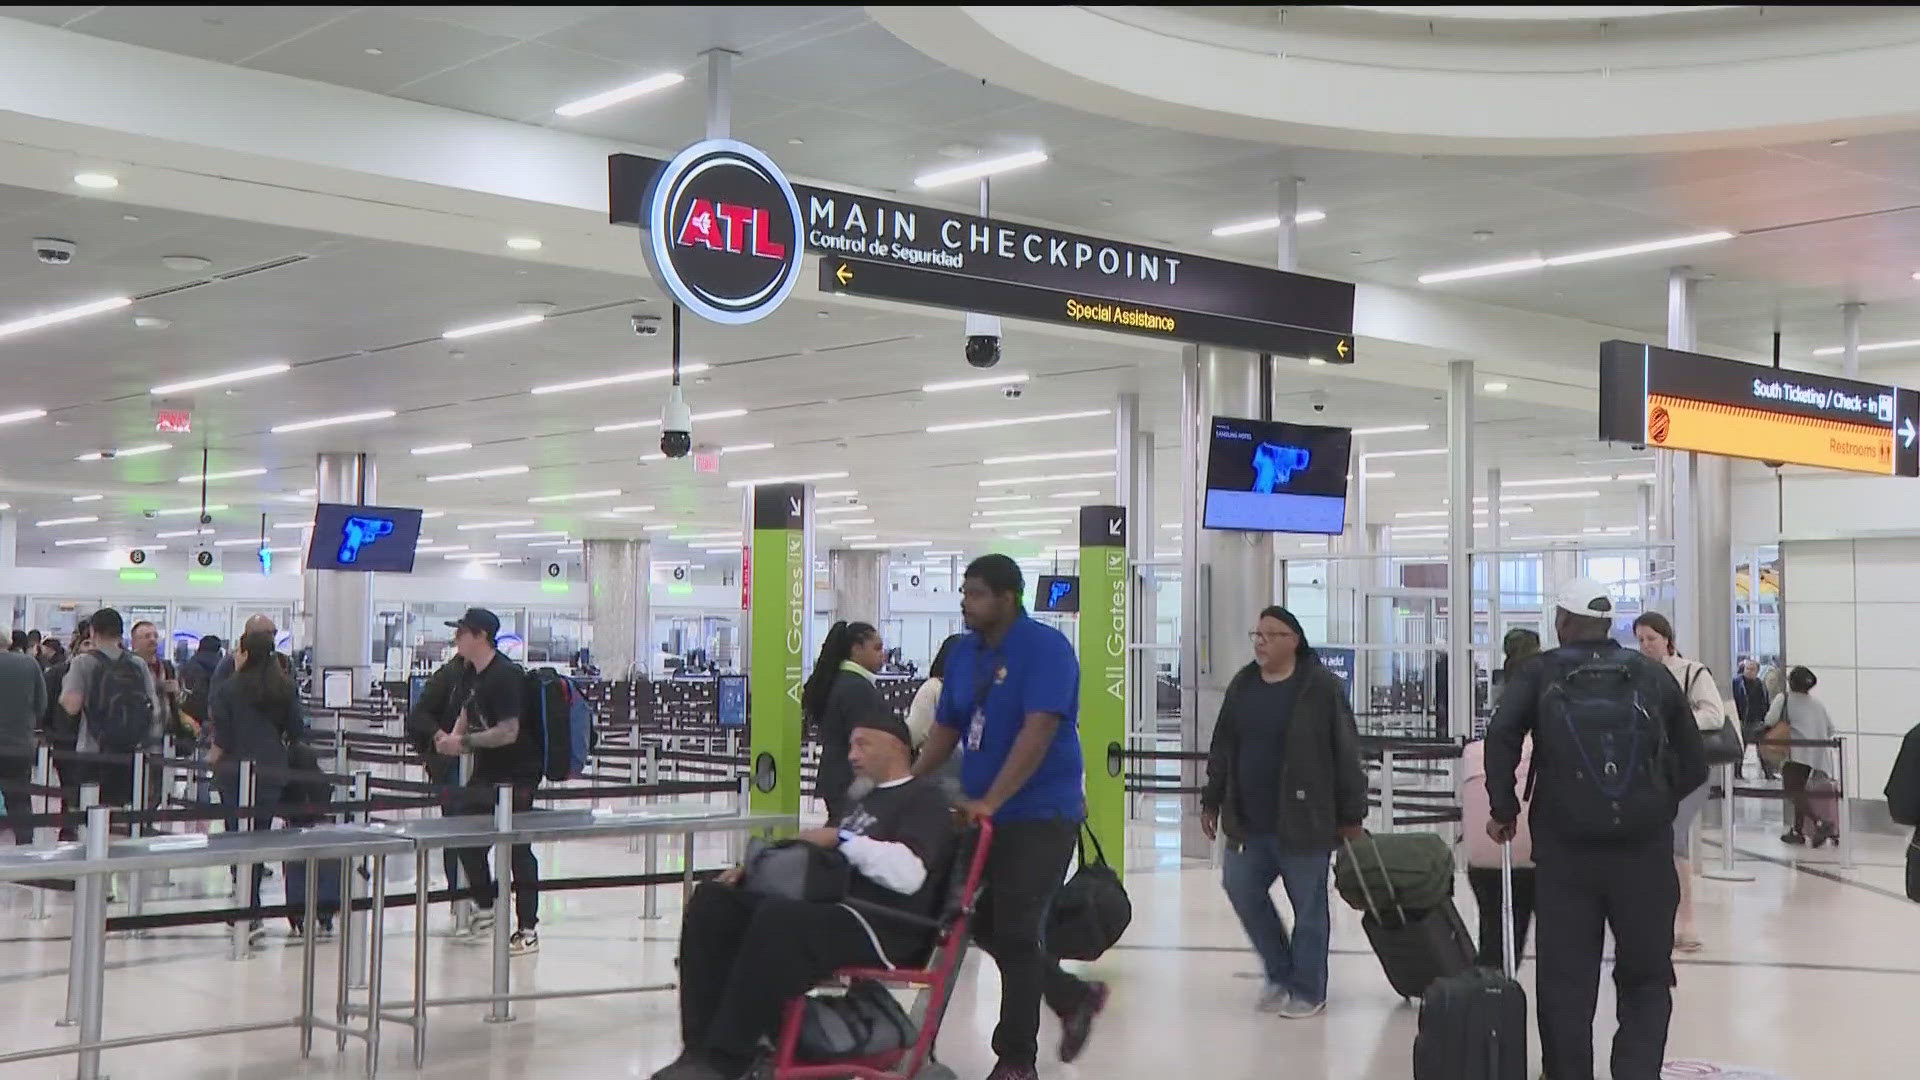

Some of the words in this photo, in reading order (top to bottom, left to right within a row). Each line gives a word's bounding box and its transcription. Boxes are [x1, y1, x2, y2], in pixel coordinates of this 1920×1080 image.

[677, 198, 785, 260] ATL
[810, 195, 916, 242] MAIN
[941, 218, 1181, 285] CHECKPOINT
[809, 230, 866, 254] Control
[869, 239, 889, 256] de
[891, 242, 964, 270] Seguridad
[1066, 298, 1112, 322] Special
[1112, 306, 1176, 333] Assistance
[1753, 378, 1782, 400] South
[1783, 382, 1827, 410] Ticketing
[1829, 437, 1877, 459] Restrooms
[786, 567, 803, 655] Gates
[1106, 580, 1125, 657] Gates
[786, 666, 802, 704] All
[1105, 666, 1124, 701] All
